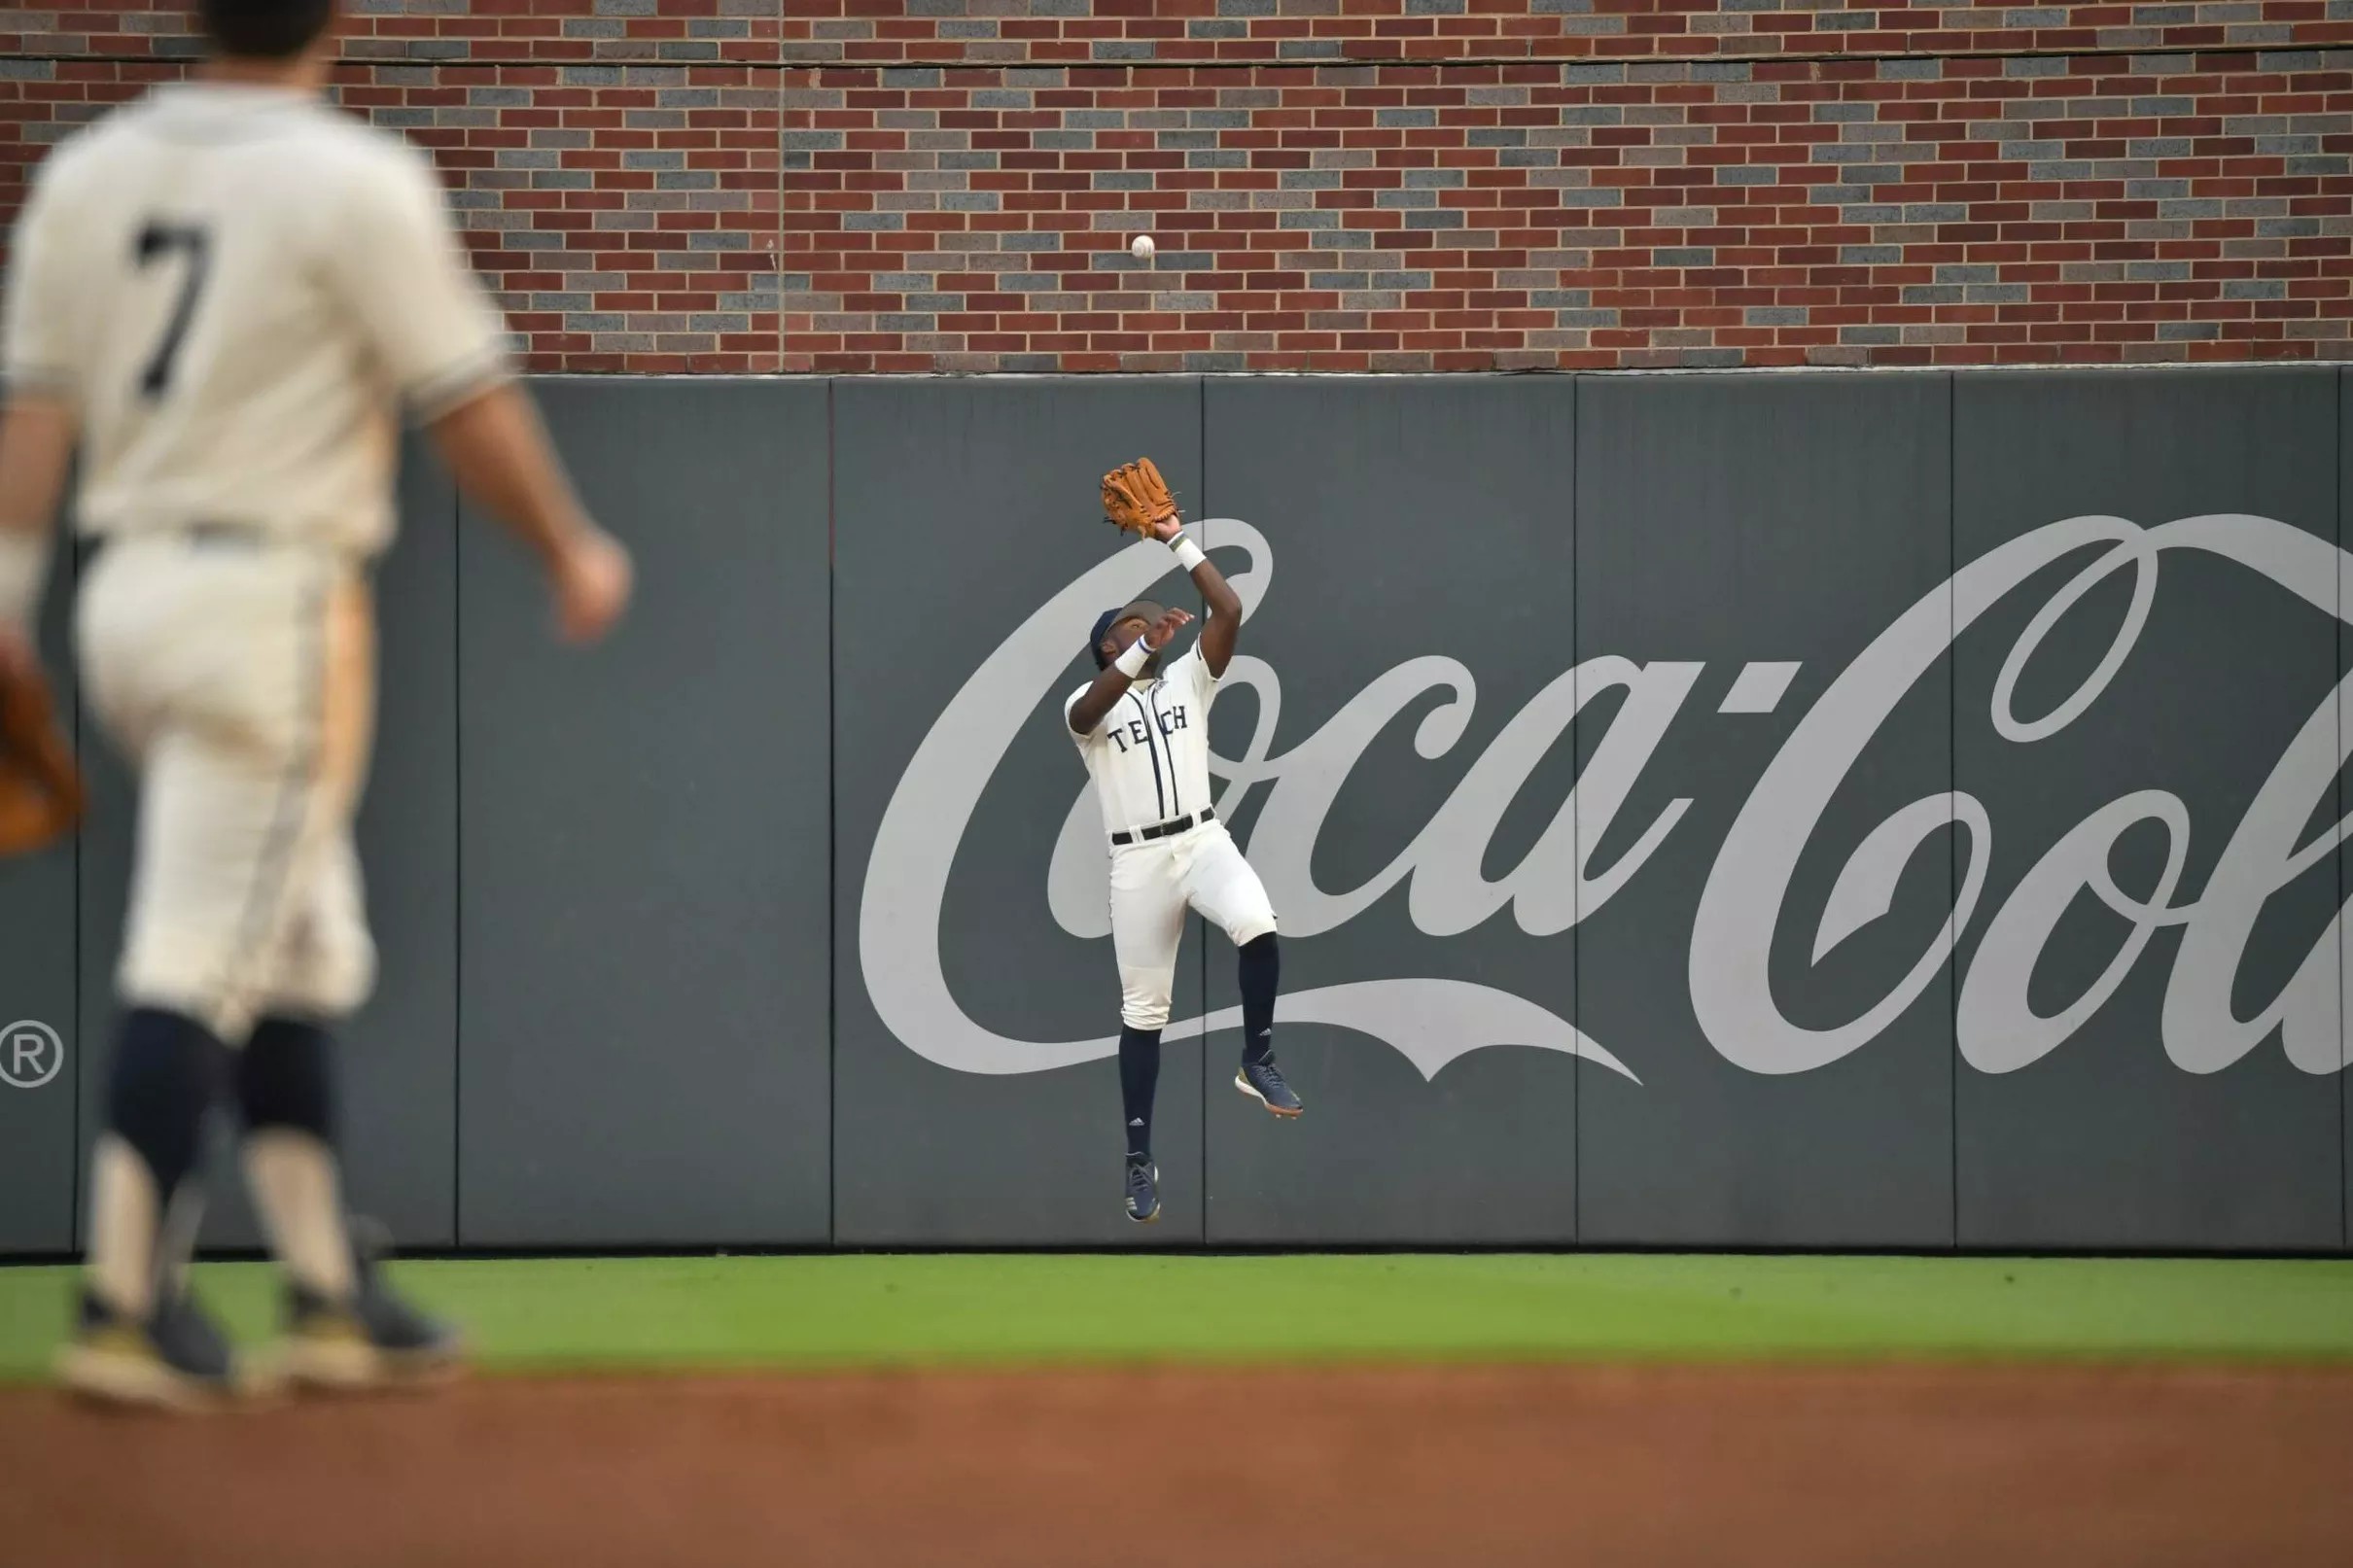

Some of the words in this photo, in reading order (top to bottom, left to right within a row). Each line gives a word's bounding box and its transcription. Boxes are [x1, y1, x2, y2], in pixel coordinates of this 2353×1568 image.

[134, 223, 212, 402] 7
[860, 514, 2353, 1084] Coca-Col
[1106, 705, 1187, 753] TECH
